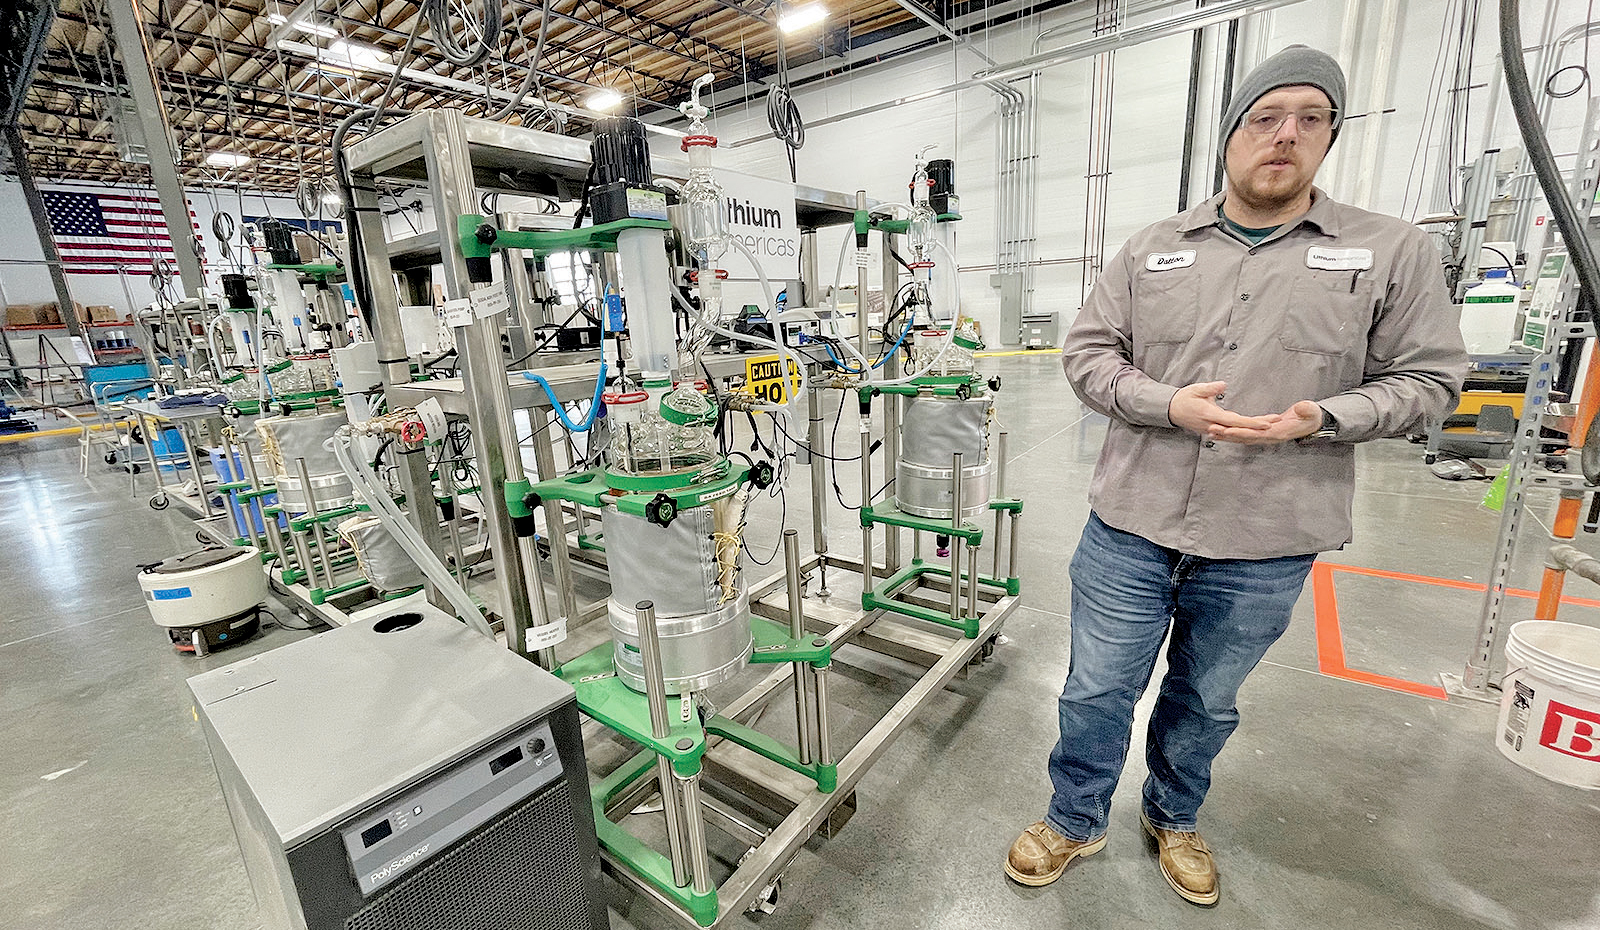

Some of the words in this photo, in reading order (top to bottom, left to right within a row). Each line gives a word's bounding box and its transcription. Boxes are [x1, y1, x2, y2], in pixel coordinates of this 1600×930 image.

[726, 197, 781, 229] thium
[729, 229, 795, 257] mericas
[752, 360, 795, 380] CAUTIN
[370, 844, 429, 884] PolyScience
